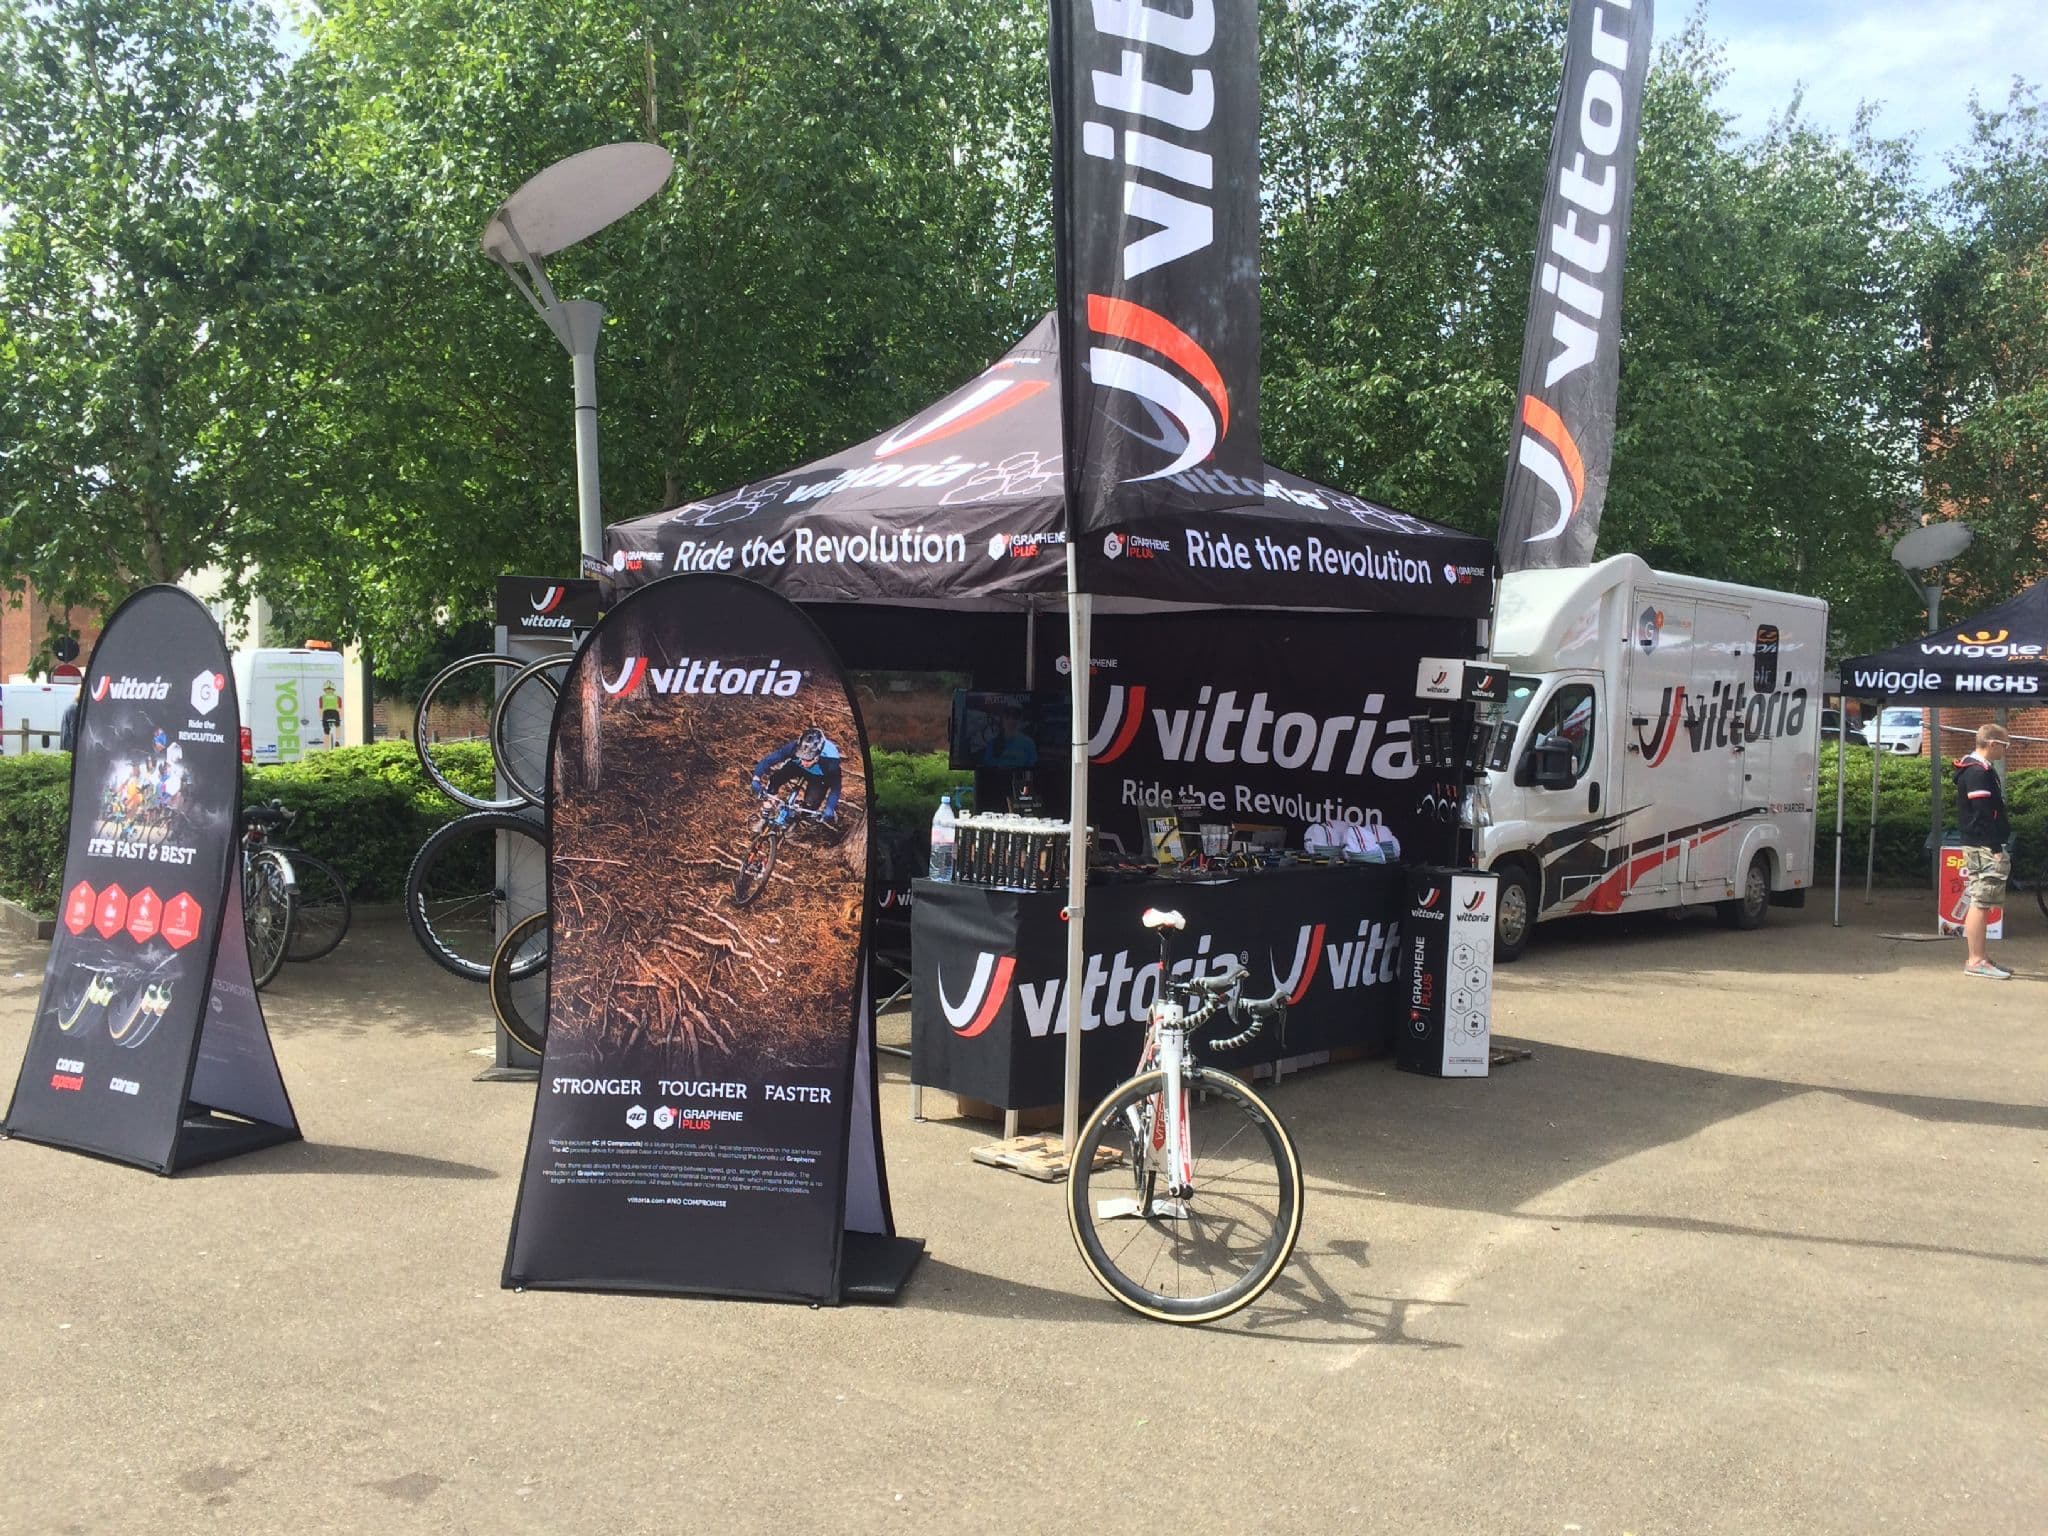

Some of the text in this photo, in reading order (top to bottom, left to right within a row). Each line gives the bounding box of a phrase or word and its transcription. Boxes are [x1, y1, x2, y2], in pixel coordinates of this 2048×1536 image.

[1541, 0, 1632, 388] vittor
[673, 525, 966, 572] Ride the Revolution
[1013, 531, 1066, 545] GRAPHENE
[1013, 544, 1039, 558] PLUS
[1130, 535, 1171, 551] GRAPHENE
[1129, 547, 1154, 559] PLUS
[1185, 528, 1433, 585] Ride the Revolution
[520, 614, 573, 629] vittoria
[1920, 643, 2043, 658] wiggle
[109, 675, 169, 700] vittoria
[650, 657, 802, 697] vittoria
[1854, 668, 2039, 695] wiggle HIGH5
[188, 719, 216, 729] Ride the
[275, 679, 300, 761] YODEL
[1681, 671, 1807, 752] vittoria
[1152, 686, 1419, 780] vittoria
[1122, 779, 1174, 808] Ride
[1178, 784, 1226, 811] the
[1234, 784, 1384, 827] Revolution
[88, 838, 197, 865] ITS FAST & BEST
[1411, 909, 1445, 921] vittoria
[1456, 911, 1490, 923] vittoria
[1326, 920, 1402, 990] vitt
[1412, 936, 1425, 1004] GRAPHENE
[1422, 973, 1433, 1007] PLUS
[552, 1078, 831, 1104] STRONGER TOUGHER FASTER
[682, 1109, 743, 1122] GRAPHENE
[682, 1120, 711, 1130] PLUS
